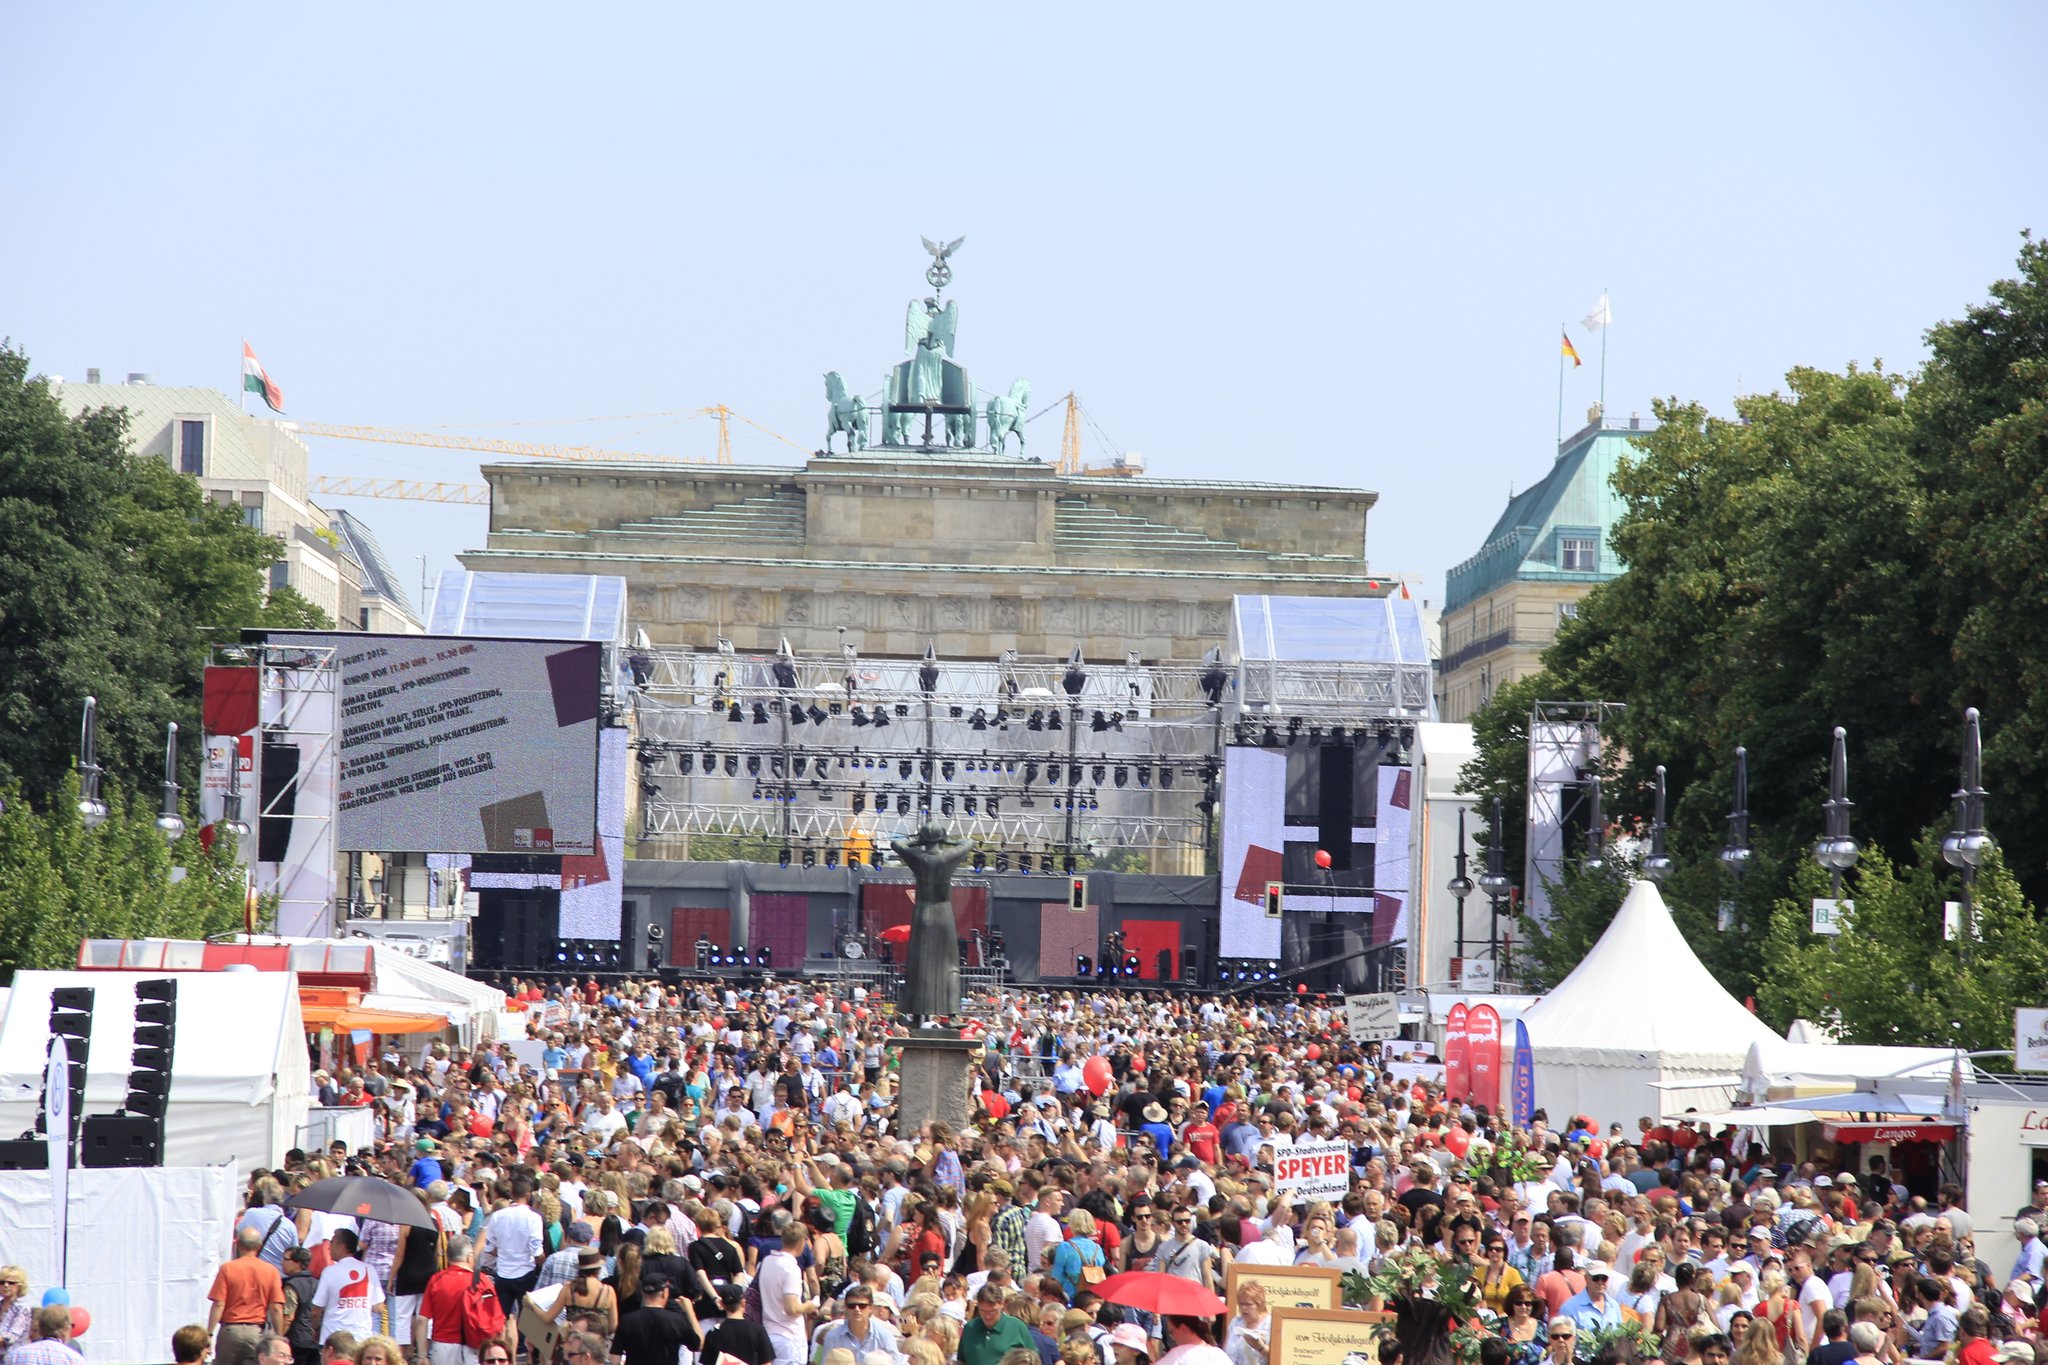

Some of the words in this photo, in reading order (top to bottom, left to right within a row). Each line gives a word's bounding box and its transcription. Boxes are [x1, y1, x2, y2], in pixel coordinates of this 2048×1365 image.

[368, 686, 399, 699] GABRIEL,
[345, 700, 384, 716] DETEKTIVE.
[386, 713, 411, 725] KRAFT,
[439, 688, 503, 711] SPD-VORSITZENDE,
[404, 719, 426, 731] NEUES
[427, 713, 445, 724] VOM
[446, 706, 473, 719] FRANZ.
[350, 751, 385, 767] BARBARA
[429, 717, 509, 745] SPD-SCHATZMEISTERIN:
[347, 767, 365, 777] VOM
[356, 775, 410, 796] FRANK-WALTER
[454, 757, 476, 768] VORS.
[477, 752, 491, 763] SPD
[443, 772, 457, 783] AUS
[1874, 1127, 1917, 1142] Langos
[1277, 1143, 1346, 1158] SPD-Stadtverband
[1277, 1154, 1346, 1180] SPEYER
[1297, 1182, 1347, 1195] Deutschland
